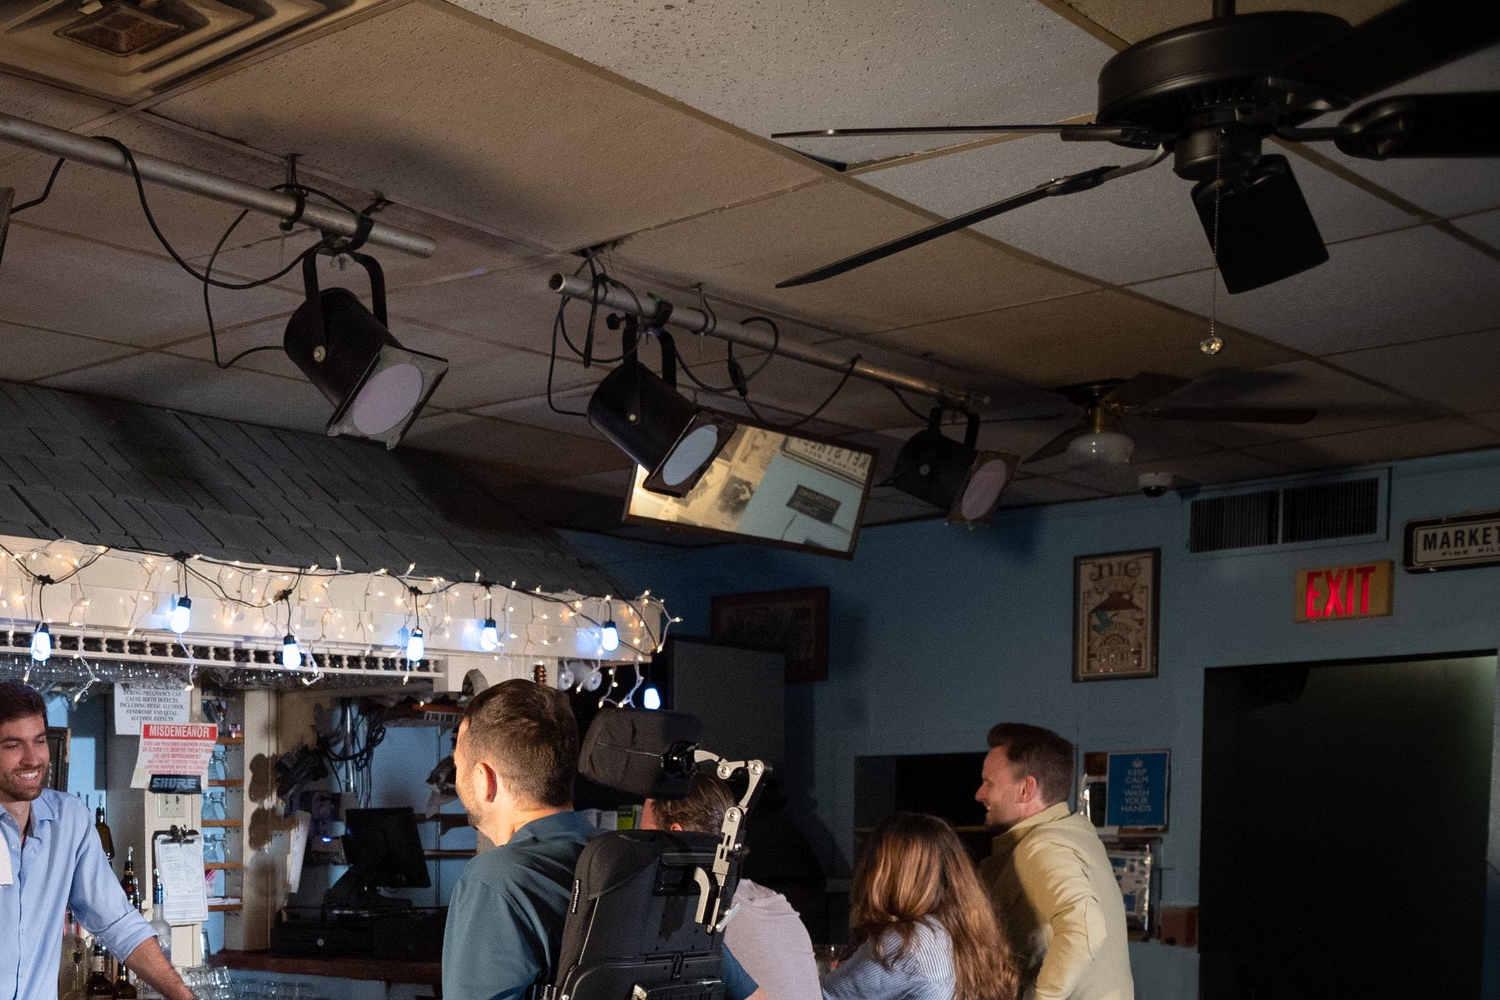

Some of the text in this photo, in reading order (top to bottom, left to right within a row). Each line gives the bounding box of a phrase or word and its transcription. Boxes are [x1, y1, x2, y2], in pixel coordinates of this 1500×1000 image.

[1423, 526, 1500, 551] MARKET
[1306, 566, 1376, 618] EXIT
[149, 725, 210, 738] MISDEMEANOR
[152, 778, 196, 789] SHURE
[1125, 776, 1149, 784] CALM
[1125, 797, 1149, 805] YOUR
[1121, 805, 1152, 813] HANDS
